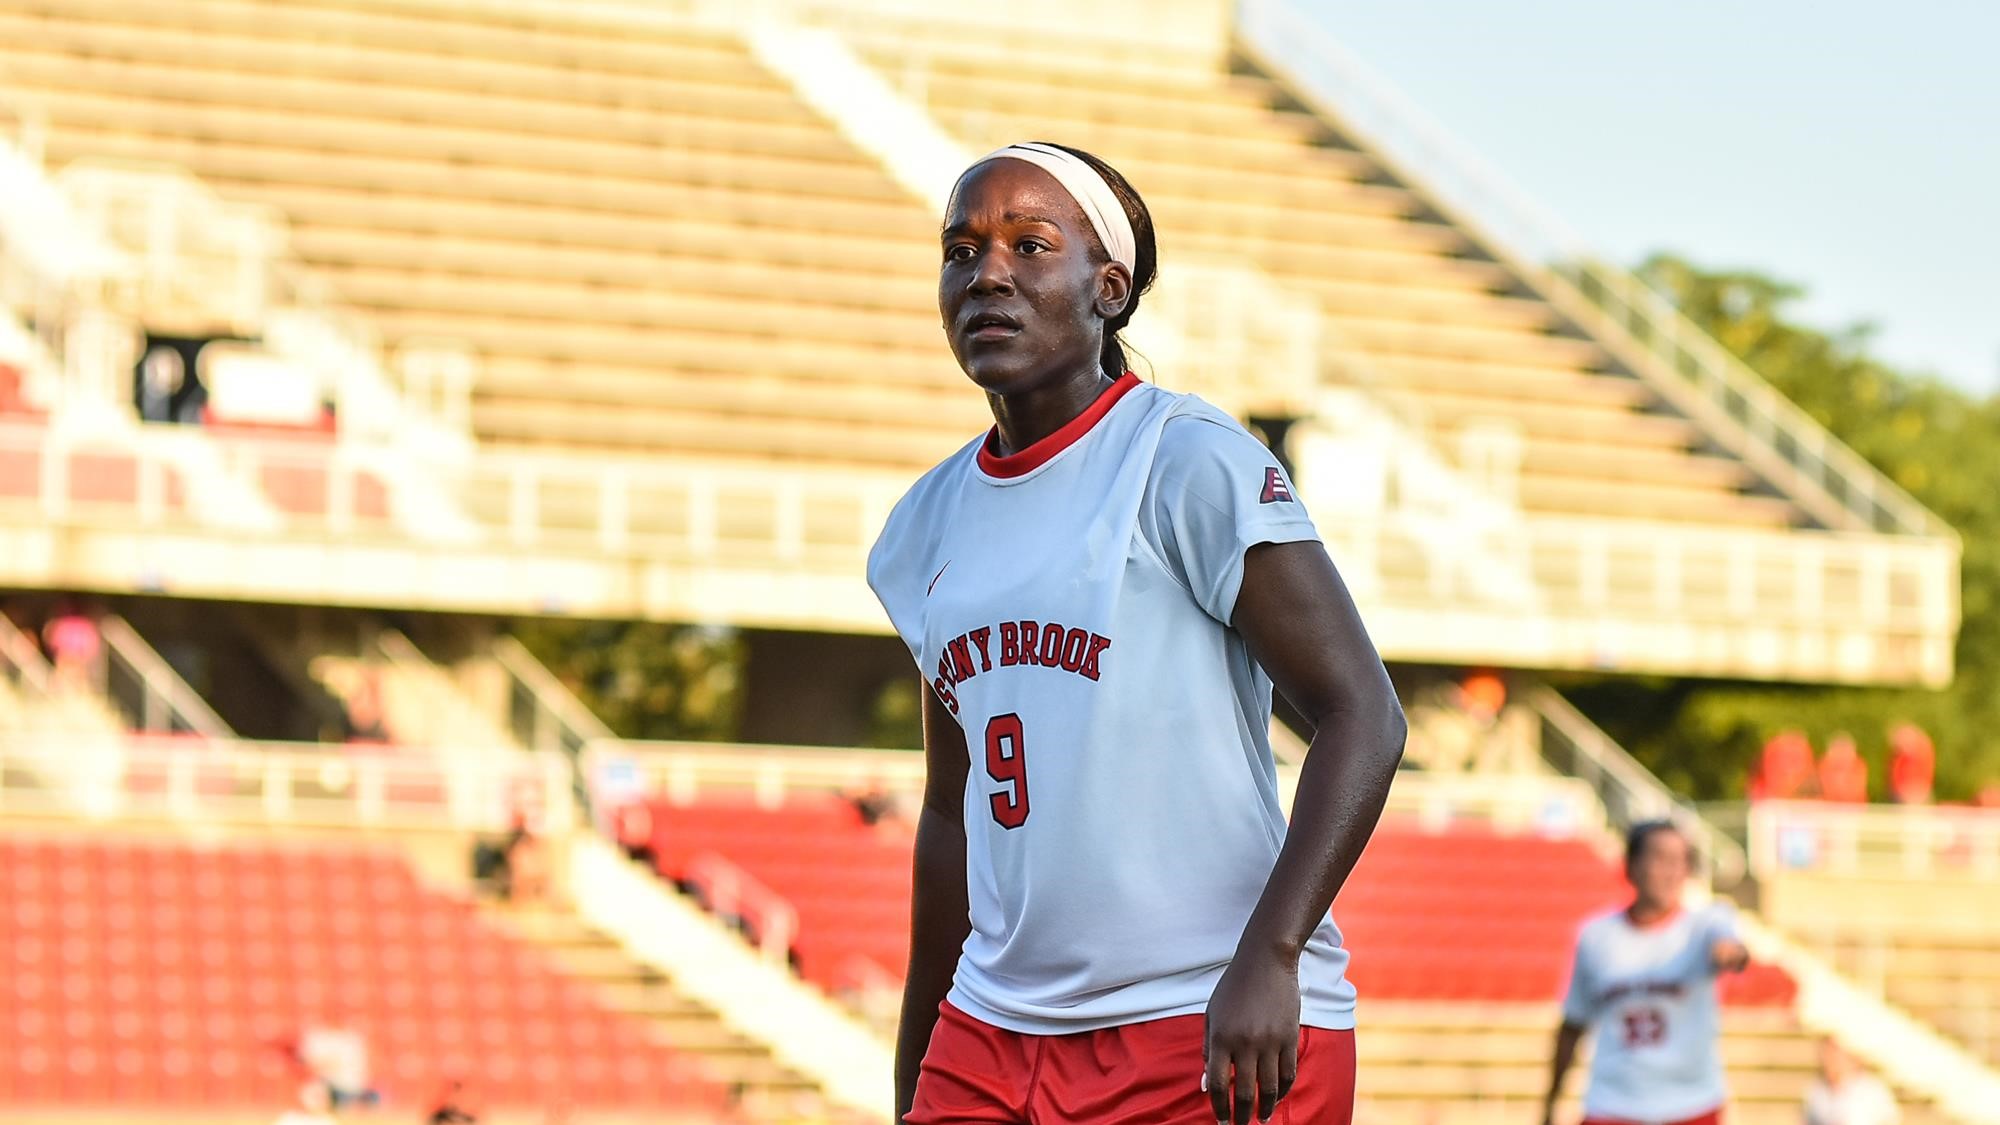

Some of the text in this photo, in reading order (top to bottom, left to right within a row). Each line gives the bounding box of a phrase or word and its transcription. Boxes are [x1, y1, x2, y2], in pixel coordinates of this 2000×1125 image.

[933, 620, 1112, 715] STNY BROOK
[985, 712, 1030, 830] 9
